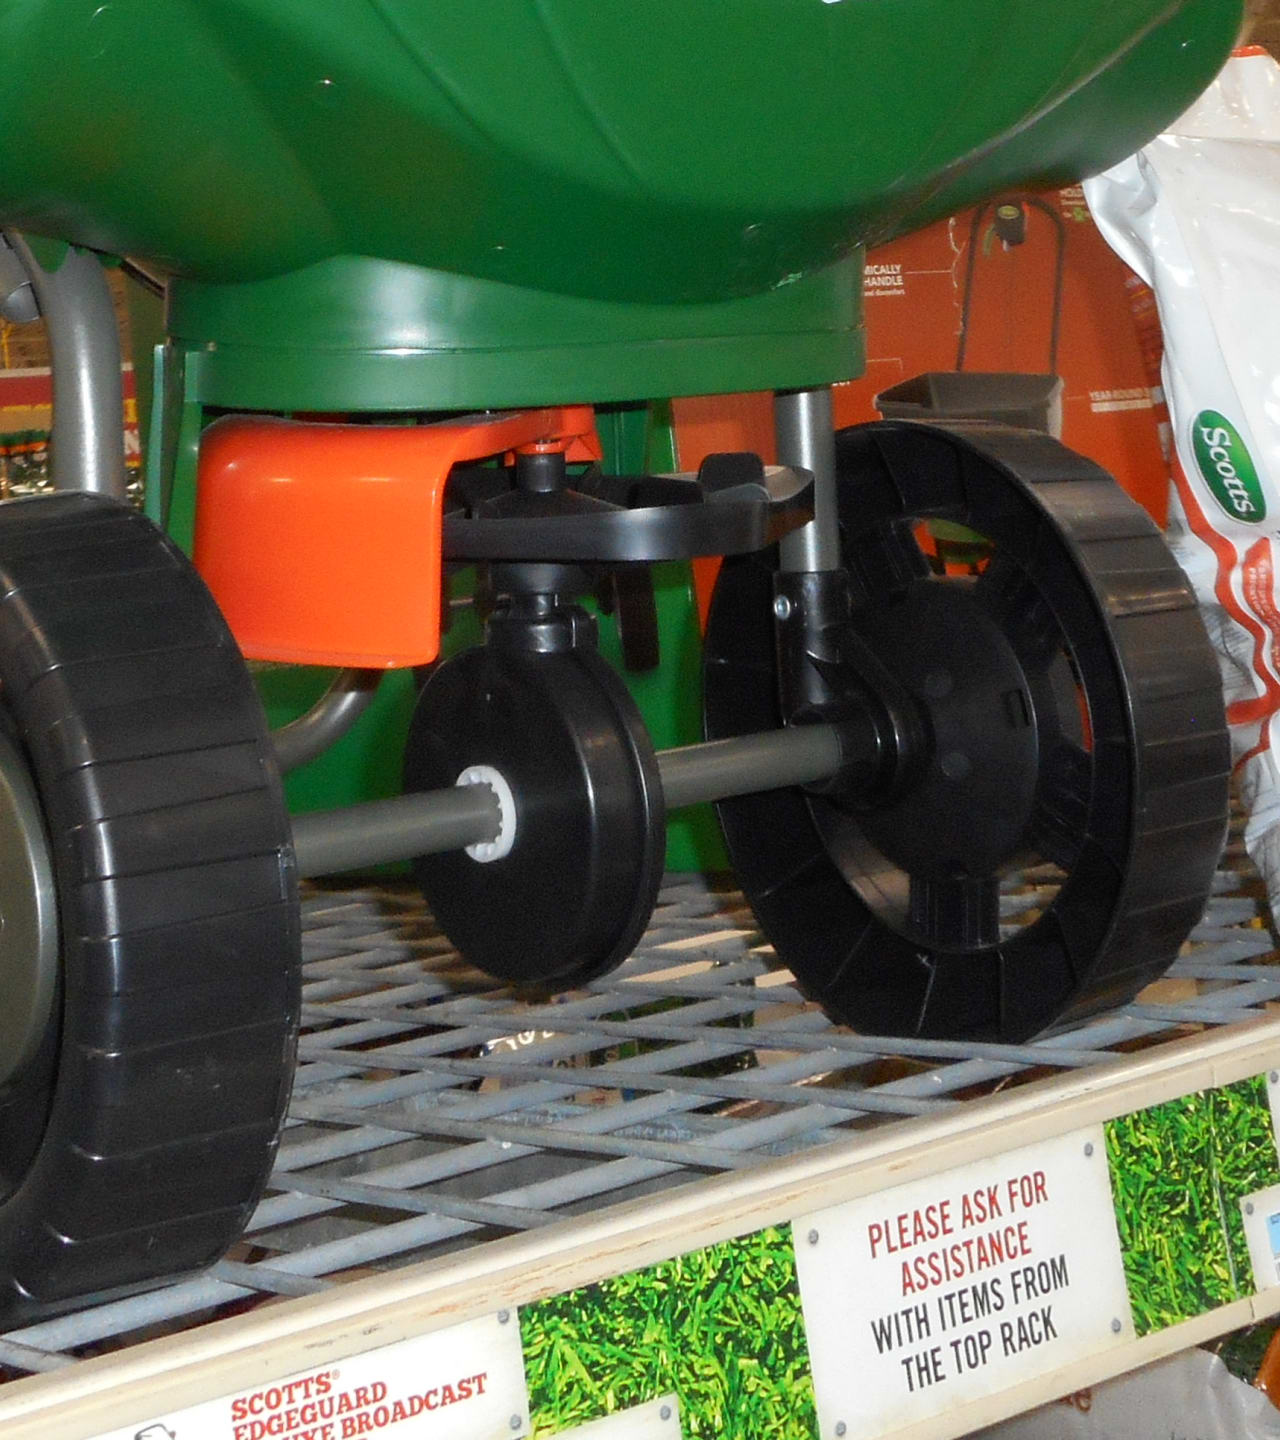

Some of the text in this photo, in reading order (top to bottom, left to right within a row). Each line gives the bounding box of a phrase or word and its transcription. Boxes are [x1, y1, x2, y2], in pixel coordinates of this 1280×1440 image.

[1201, 426, 1255, 515] Scotts
[868, 1171, 1048, 1259] PLEASE ASK FOR
[901, 1221, 1032, 1297] ASSISTANCE
[871, 1254, 1070, 1354] WITH ITEMS FROM
[901, 1305, 1058, 1392] THE TOP RACK
[231, 1371, 333, 1422] SCOTTS
[233, 1381, 388, 1440] EDGEGUARD
[340, 1372, 489, 1439] BROADCAST
